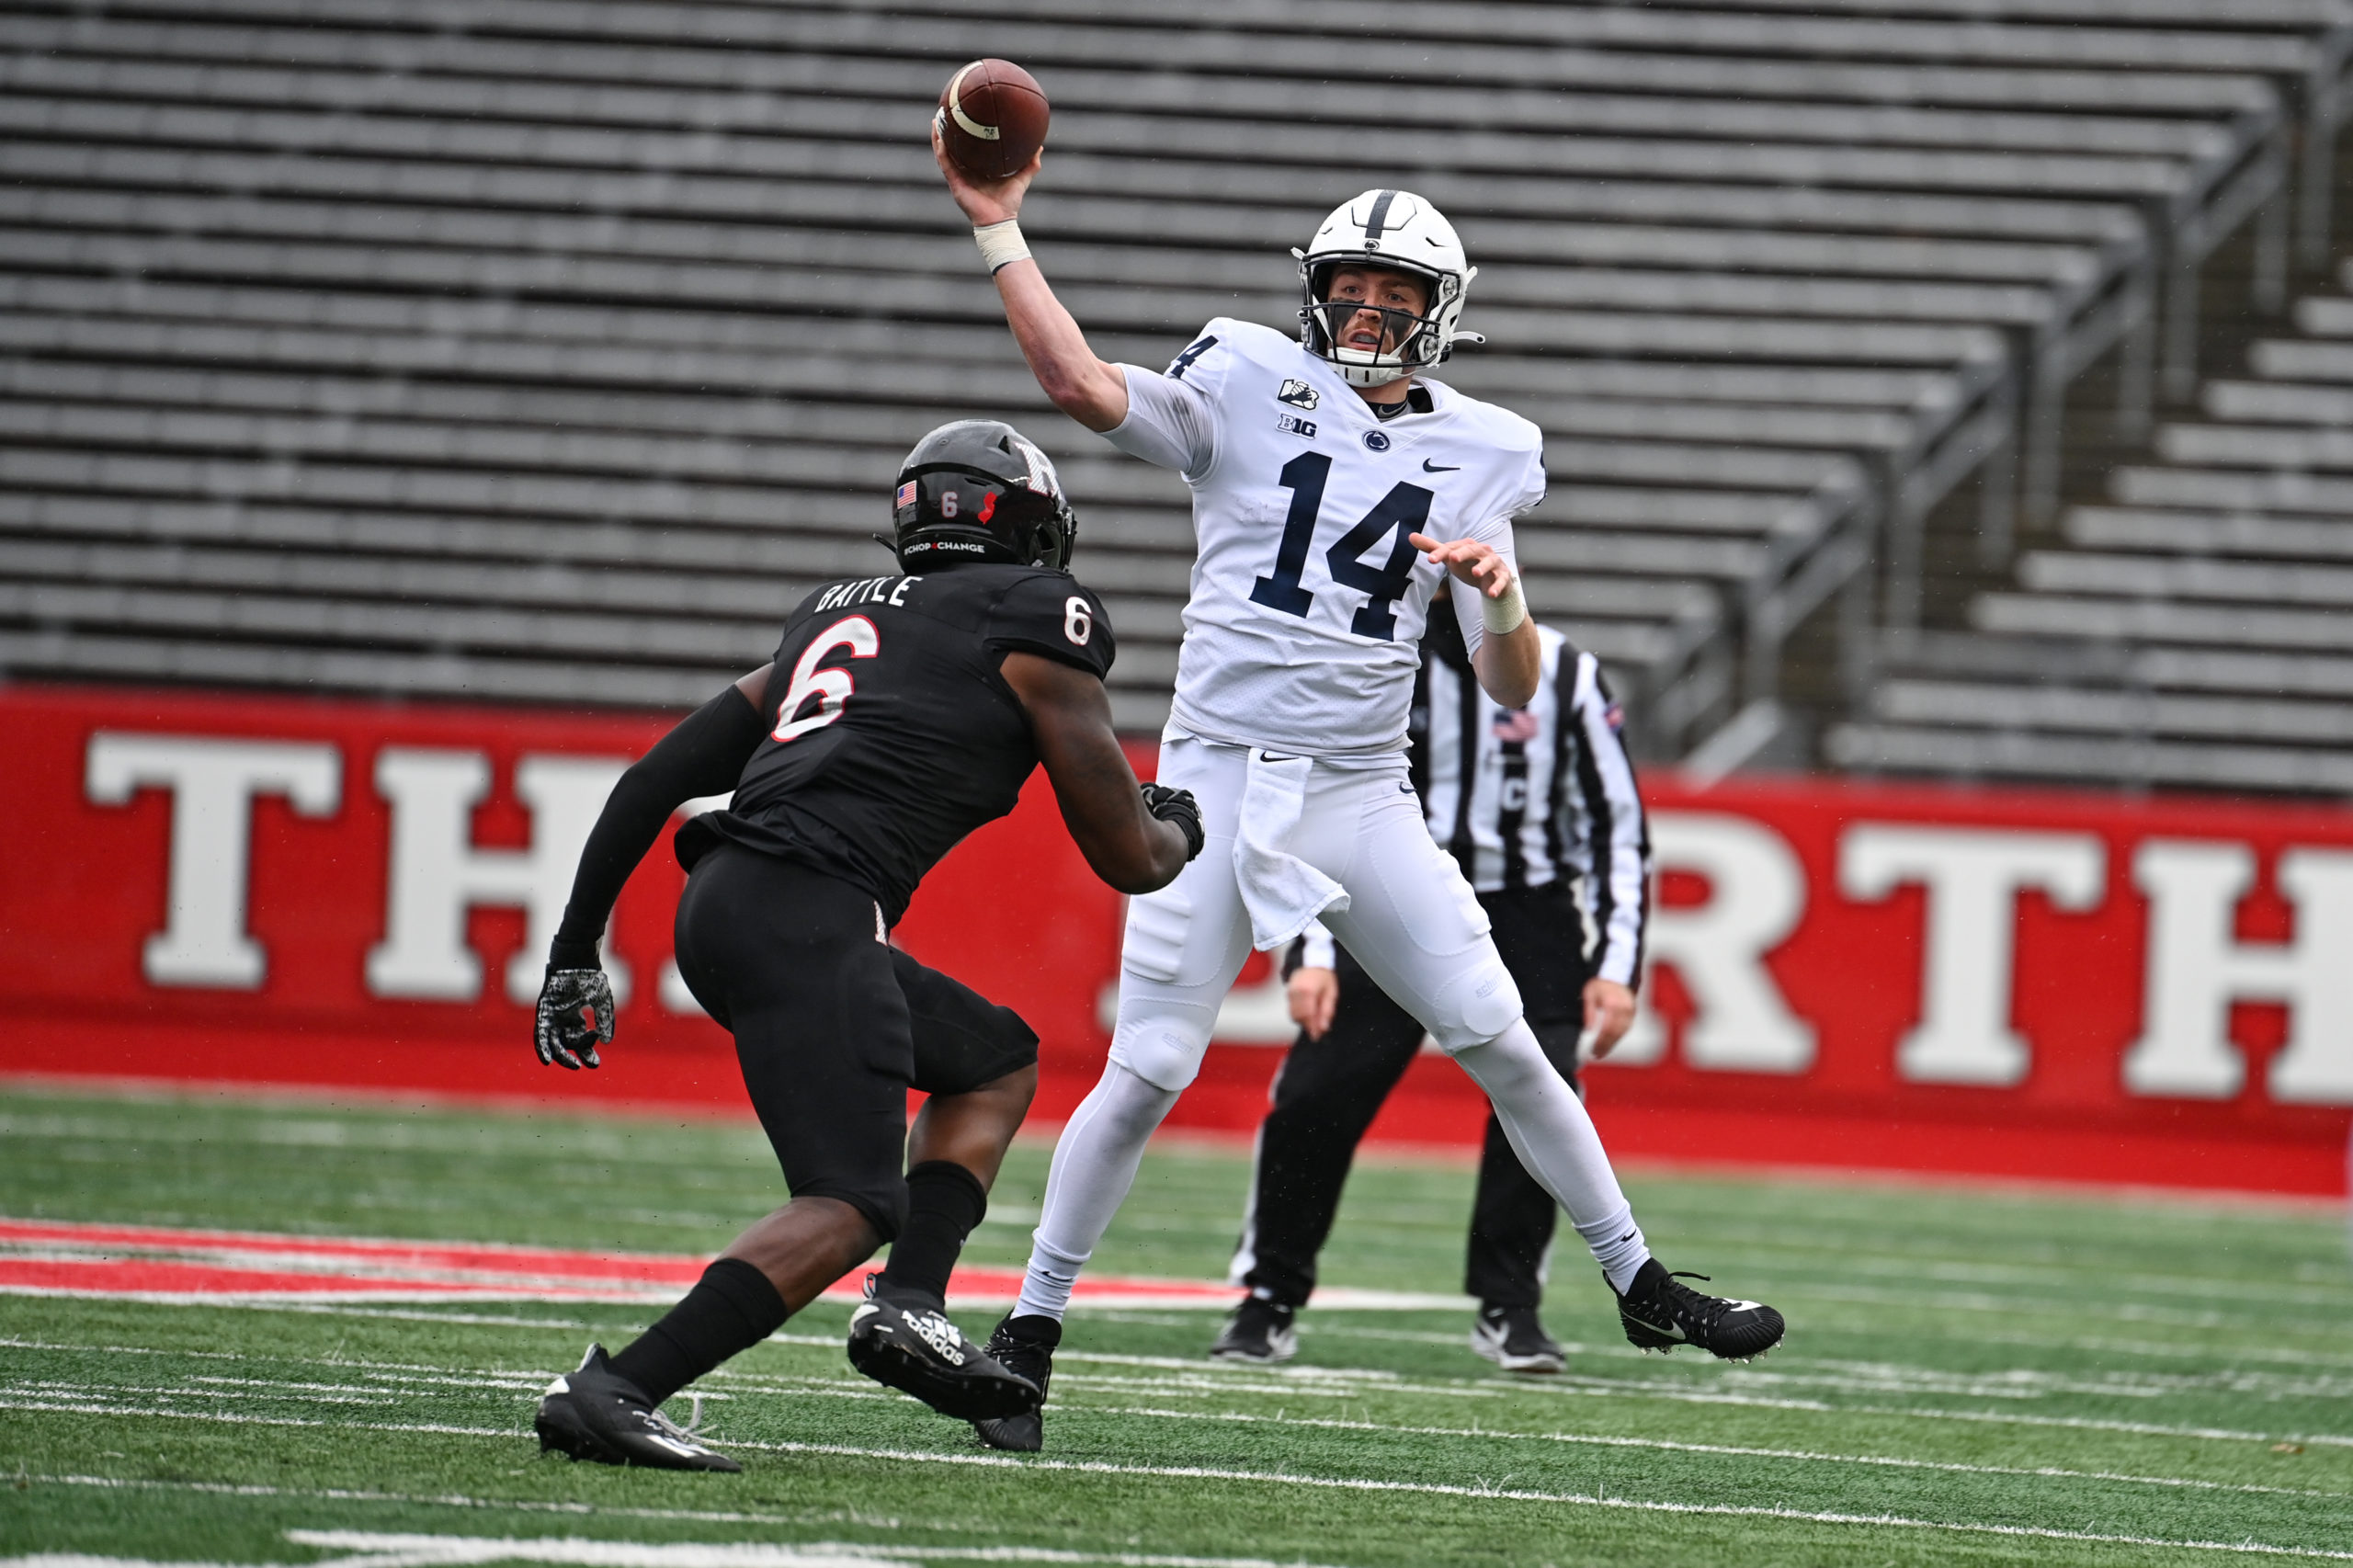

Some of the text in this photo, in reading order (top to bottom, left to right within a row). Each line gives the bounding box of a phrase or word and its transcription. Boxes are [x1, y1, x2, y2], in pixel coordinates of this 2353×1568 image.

[941, 491, 958, 518] 6
[1249, 450, 1435, 642] 14
[813, 575, 924, 613] BATTLE
[1063, 596, 1093, 646] 6
[770, 614, 881, 743] 6
[85, 731, 735, 1017] TH
[906, 1316, 965, 1367] adidas
